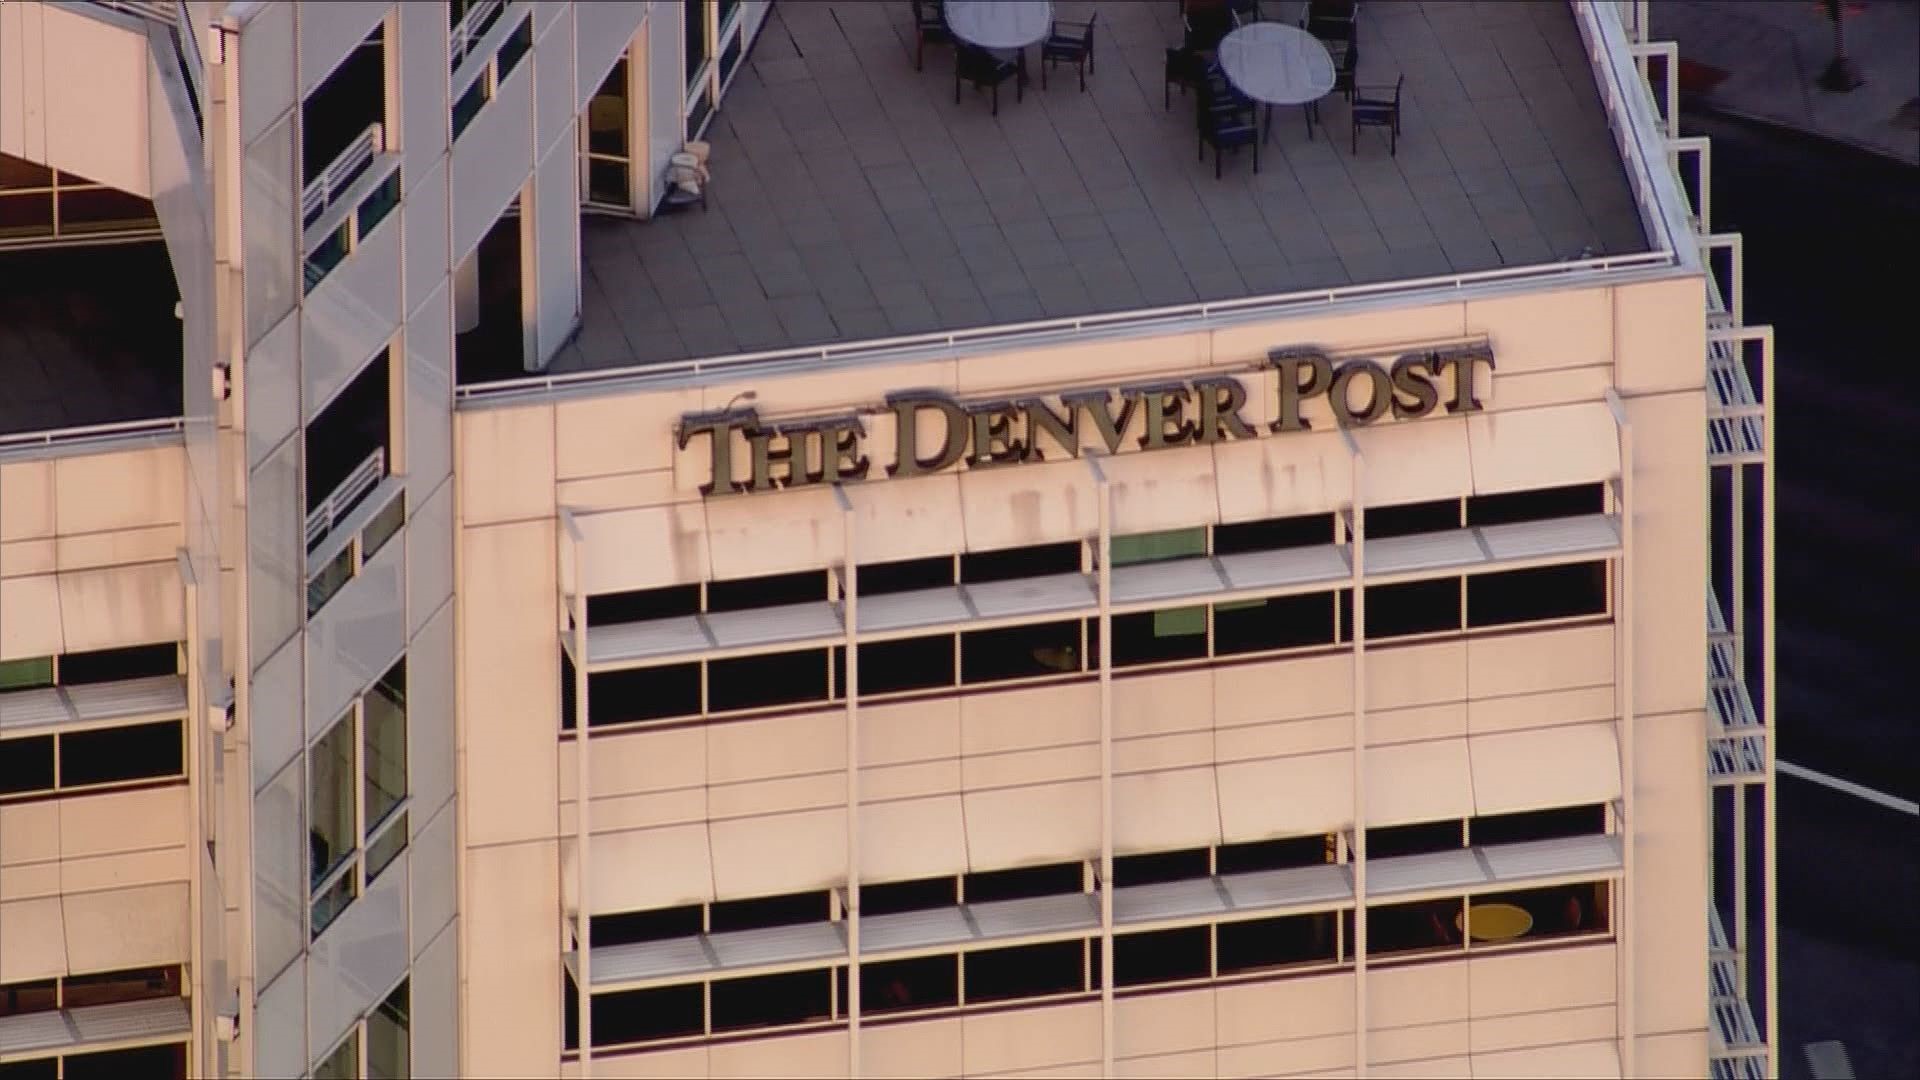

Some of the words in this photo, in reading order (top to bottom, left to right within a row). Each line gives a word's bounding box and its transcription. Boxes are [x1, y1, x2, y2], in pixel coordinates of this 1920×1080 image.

[679, 408, 869, 496] THE
[886, 376, 1257, 479] DENVER
[1269, 343, 1495, 431] POST
